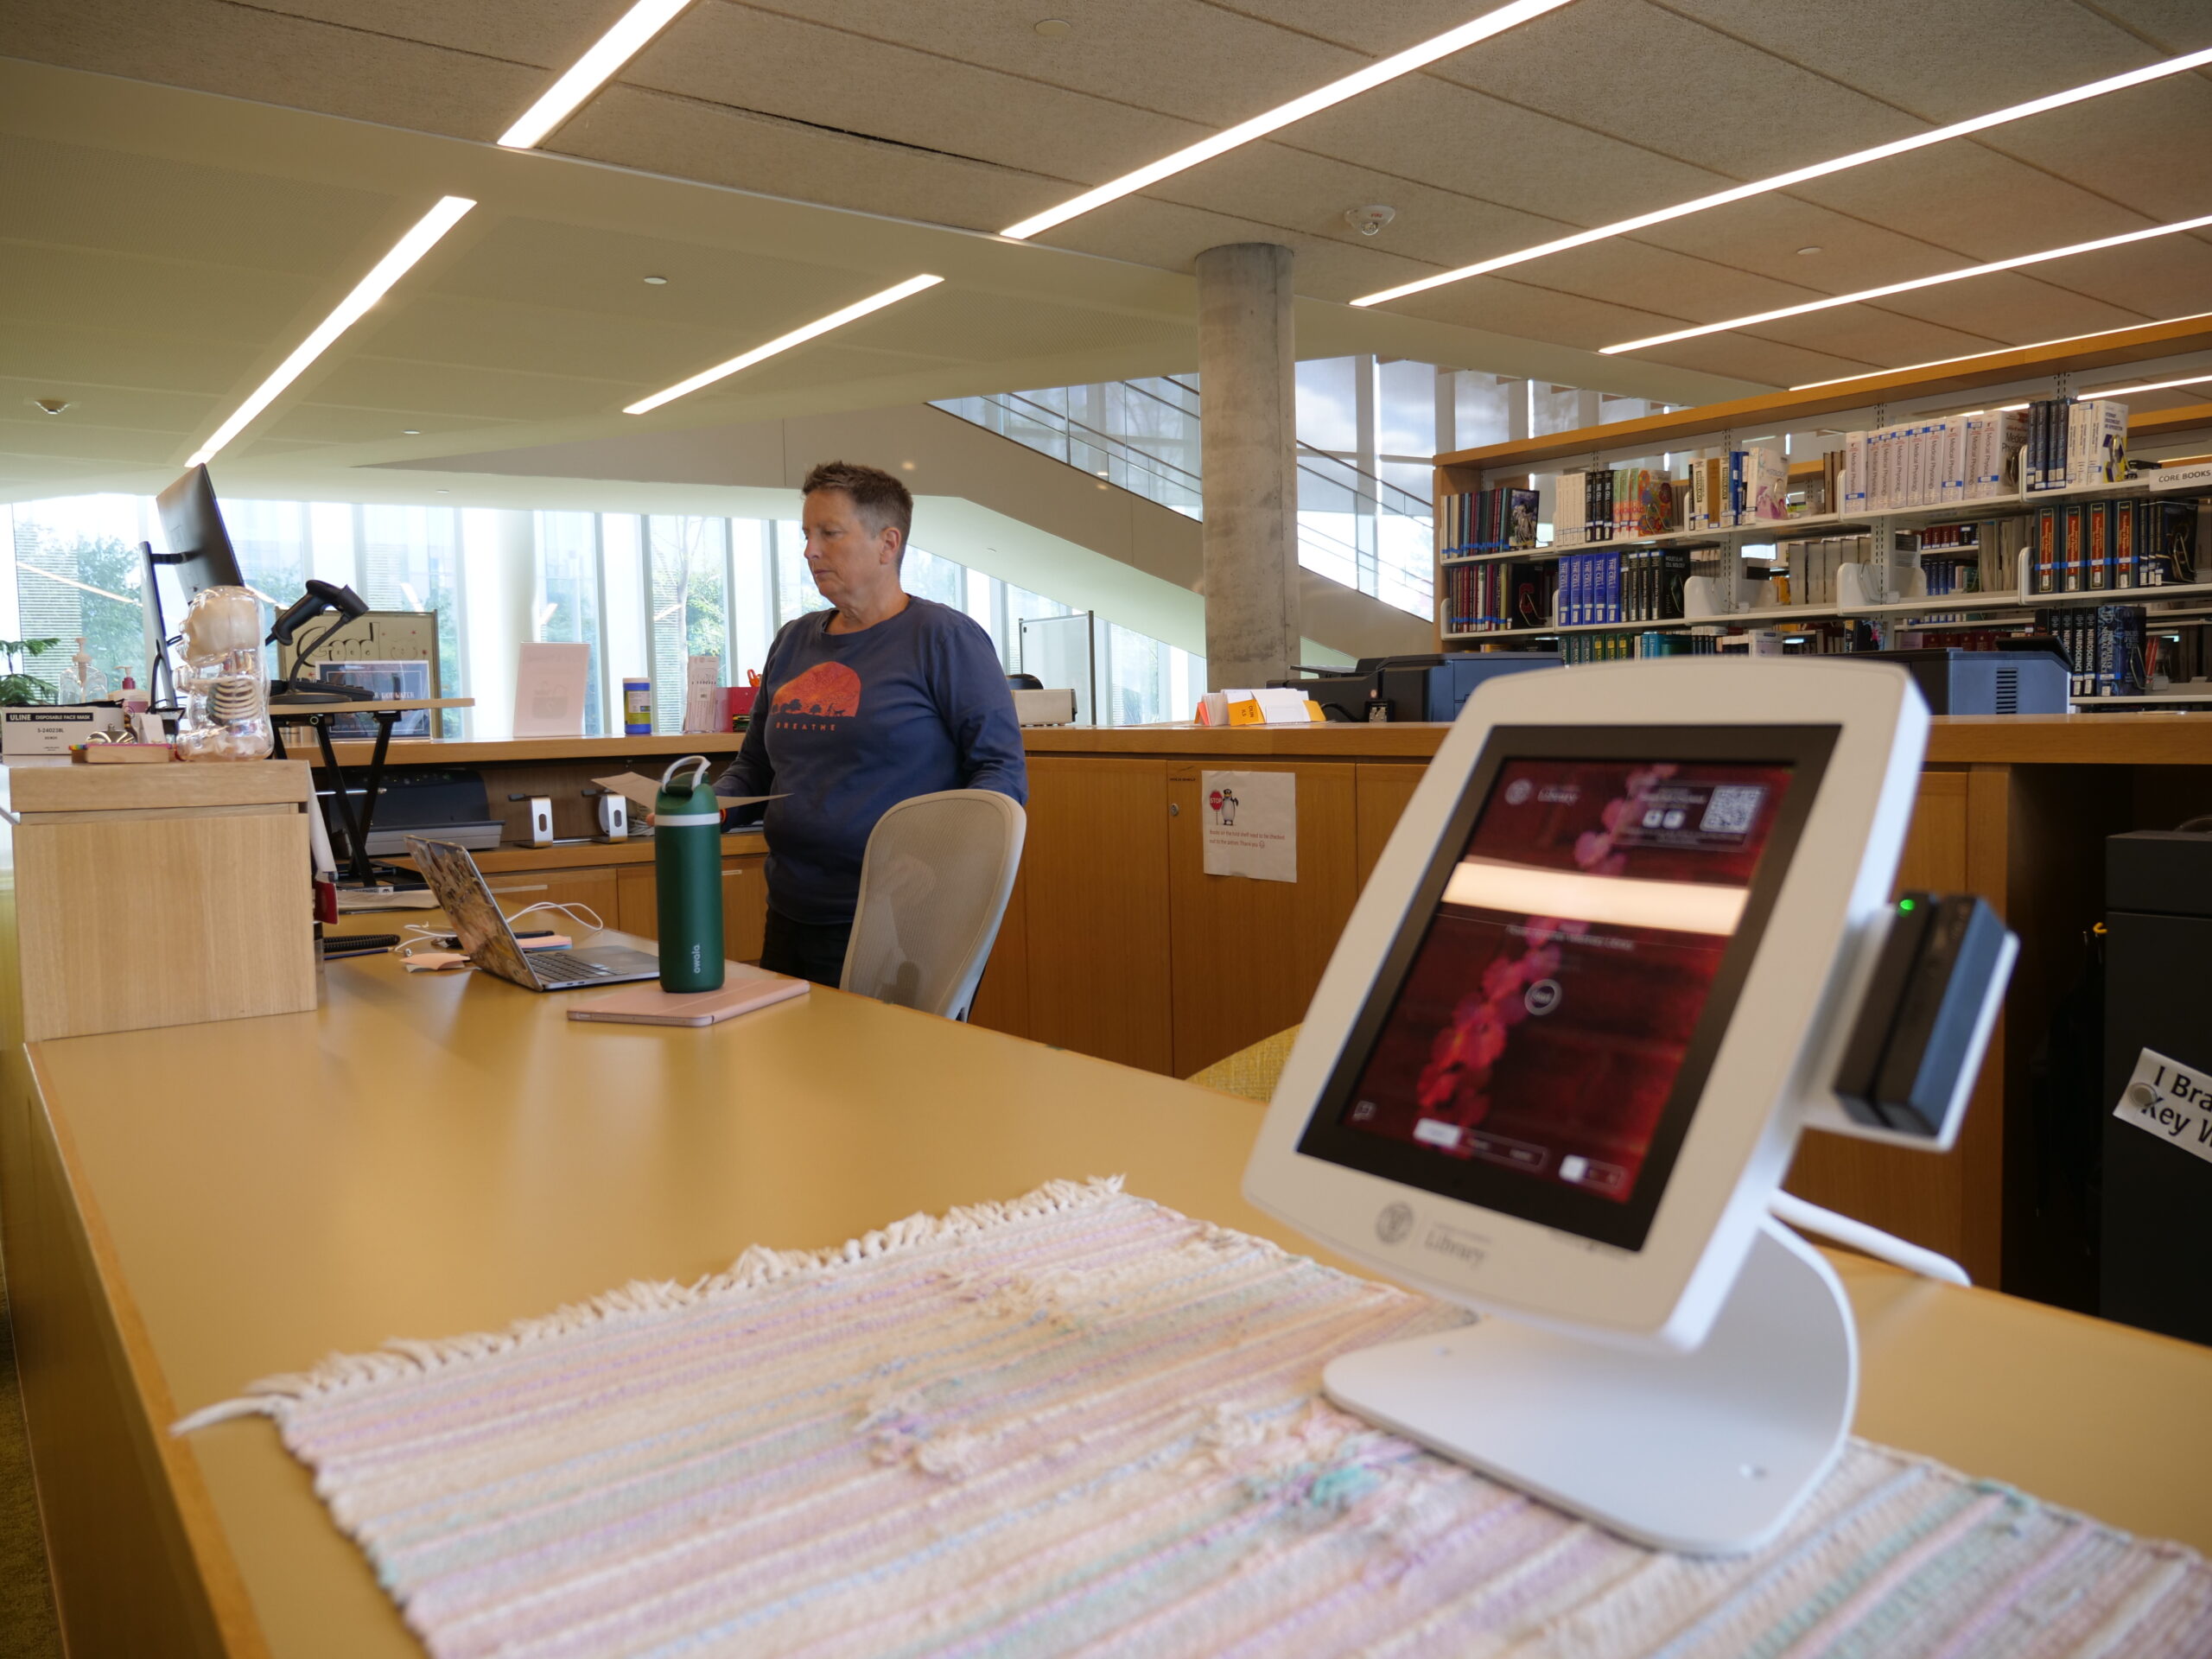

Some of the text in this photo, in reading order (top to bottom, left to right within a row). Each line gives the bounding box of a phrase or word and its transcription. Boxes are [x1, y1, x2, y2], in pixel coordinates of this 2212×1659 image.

[2005, 432, 2026, 443] Medica
[2158, 470, 2211, 482] CORE BOOKS
[2075, 629, 2083, 672] NEUROSCIENCE
[2086, 628, 2094, 671] NEUROSCIENCE
[775, 721, 836, 732] BREATHE
[691, 943, 701, 974] owala
[2153, 1065, 2212, 1115] I Bra
[2141, 1096, 2191, 1137] Key
[1423, 1231, 1486, 1268] Library
